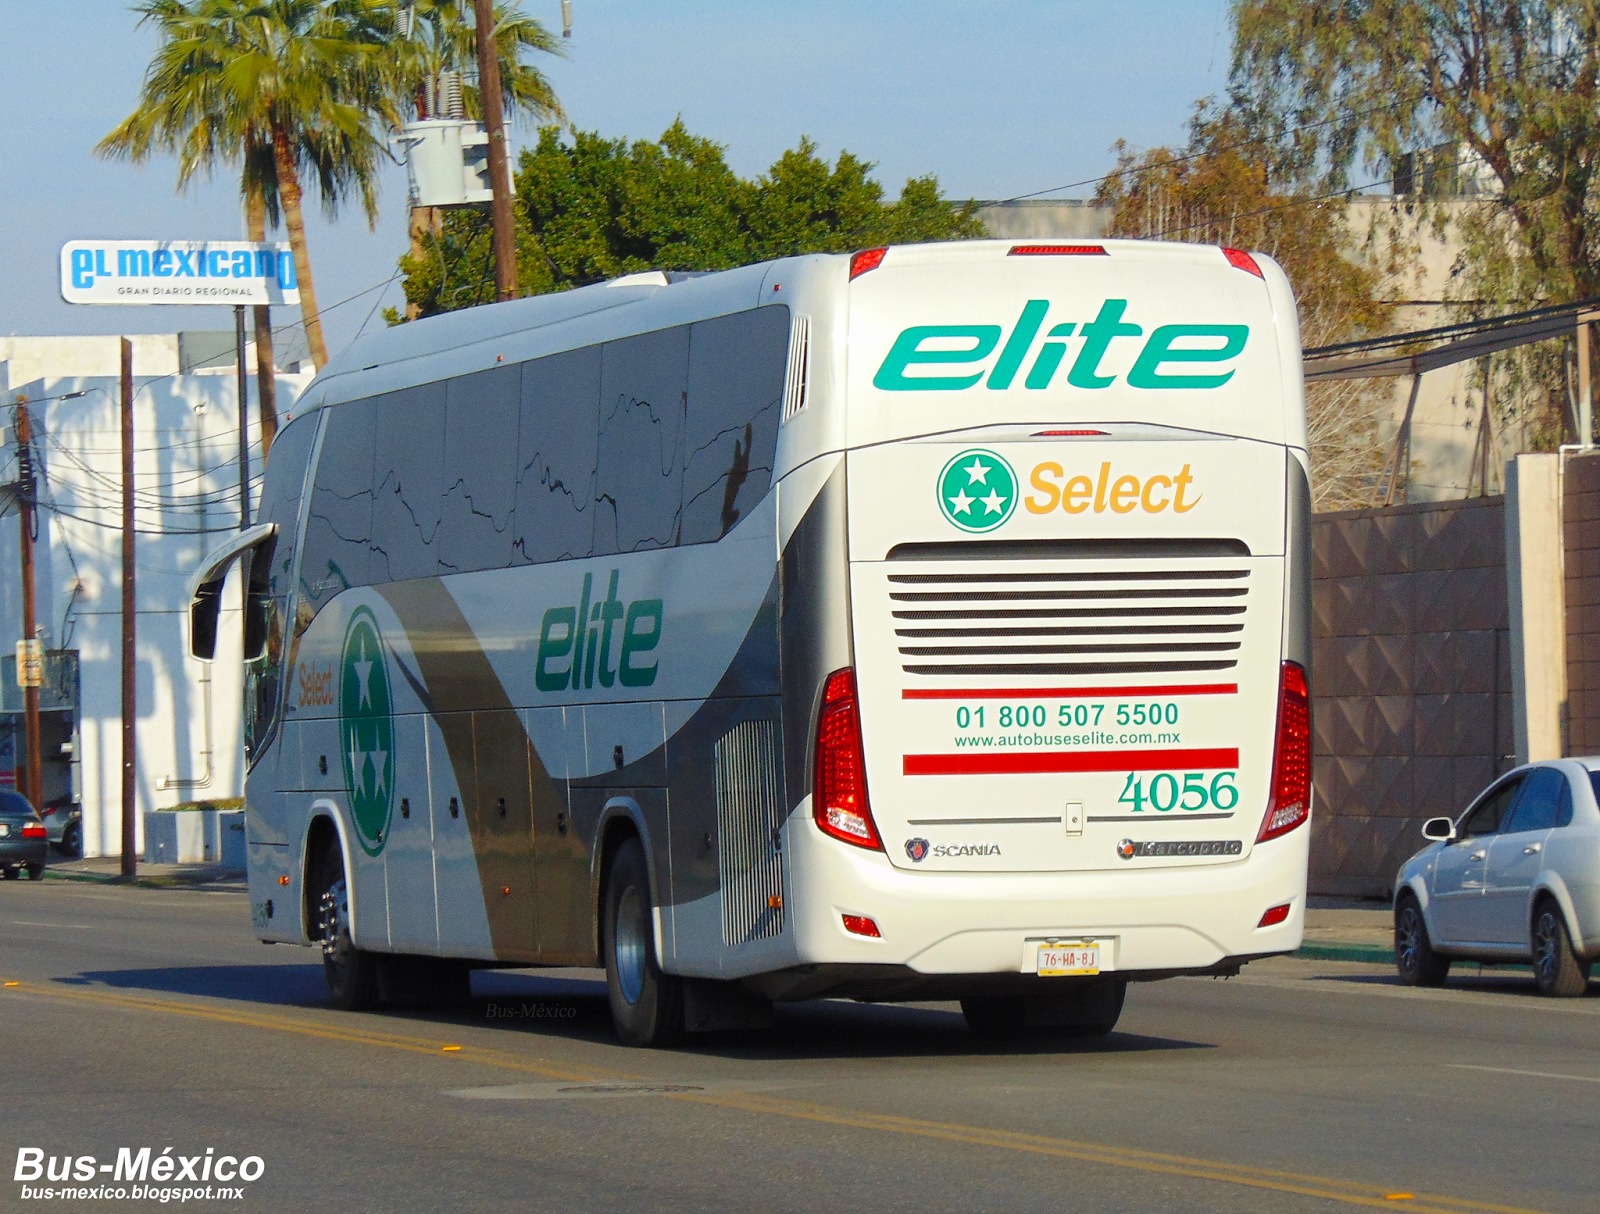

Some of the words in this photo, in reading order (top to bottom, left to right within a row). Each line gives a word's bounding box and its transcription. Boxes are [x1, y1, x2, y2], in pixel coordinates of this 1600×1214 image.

[118, 287, 149, 295] GRAN
[153, 287, 192, 295] DIARIO
[196, 287, 253, 296] REGIONAL
[873, 299, 1249, 391] elite
[1024, 461, 1203, 515] Select
[536, 568, 663, 691] elite
[299, 660, 334, 707] Select
[956, 706, 985, 728] 01
[999, 705, 1046, 727] 800
[1058, 704, 1105, 726] 507
[1116, 703, 1179, 725] 5500
[955, 731, 1181, 747] www.autobuseselite.com.mx
[1118, 771, 1239, 812] 4056
[933, 844, 1002, 857] SCANIA
[1139, 840, 1240, 855] Marcopolo
[1044, 952, 1095, 966] 76-HA-8J
